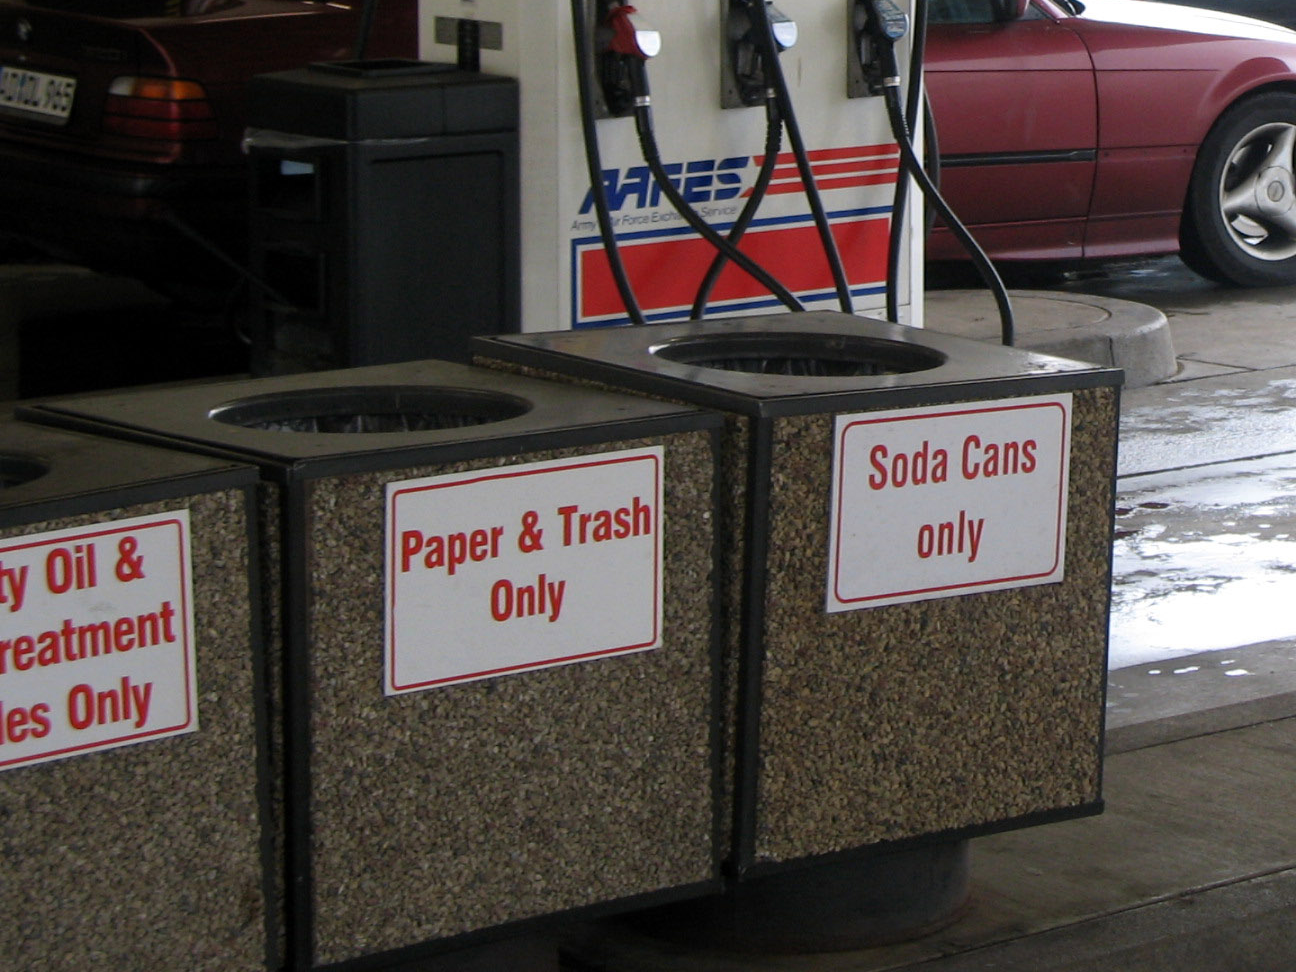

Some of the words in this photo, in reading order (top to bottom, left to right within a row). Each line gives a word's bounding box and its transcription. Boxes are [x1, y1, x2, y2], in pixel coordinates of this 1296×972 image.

[577, 155, 750, 215] AAFES
[570, 219, 596, 232] Army
[621, 213, 649, 226] Force
[701, 206, 738, 218] Service
[868, 440, 949, 491] Soda
[961, 434, 1038, 480] Cans
[401, 525, 505, 576] Paper
[518, 510, 545, 554] &
[556, 496, 652, 547] Trash
[916, 509, 985, 564] only
[45, 542, 98, 595] Oil
[115, 535, 146, 583] &
[490, 573, 567, 623] Only
[0, 600, 177, 675] reatment
[67, 675, 154, 730] Only
